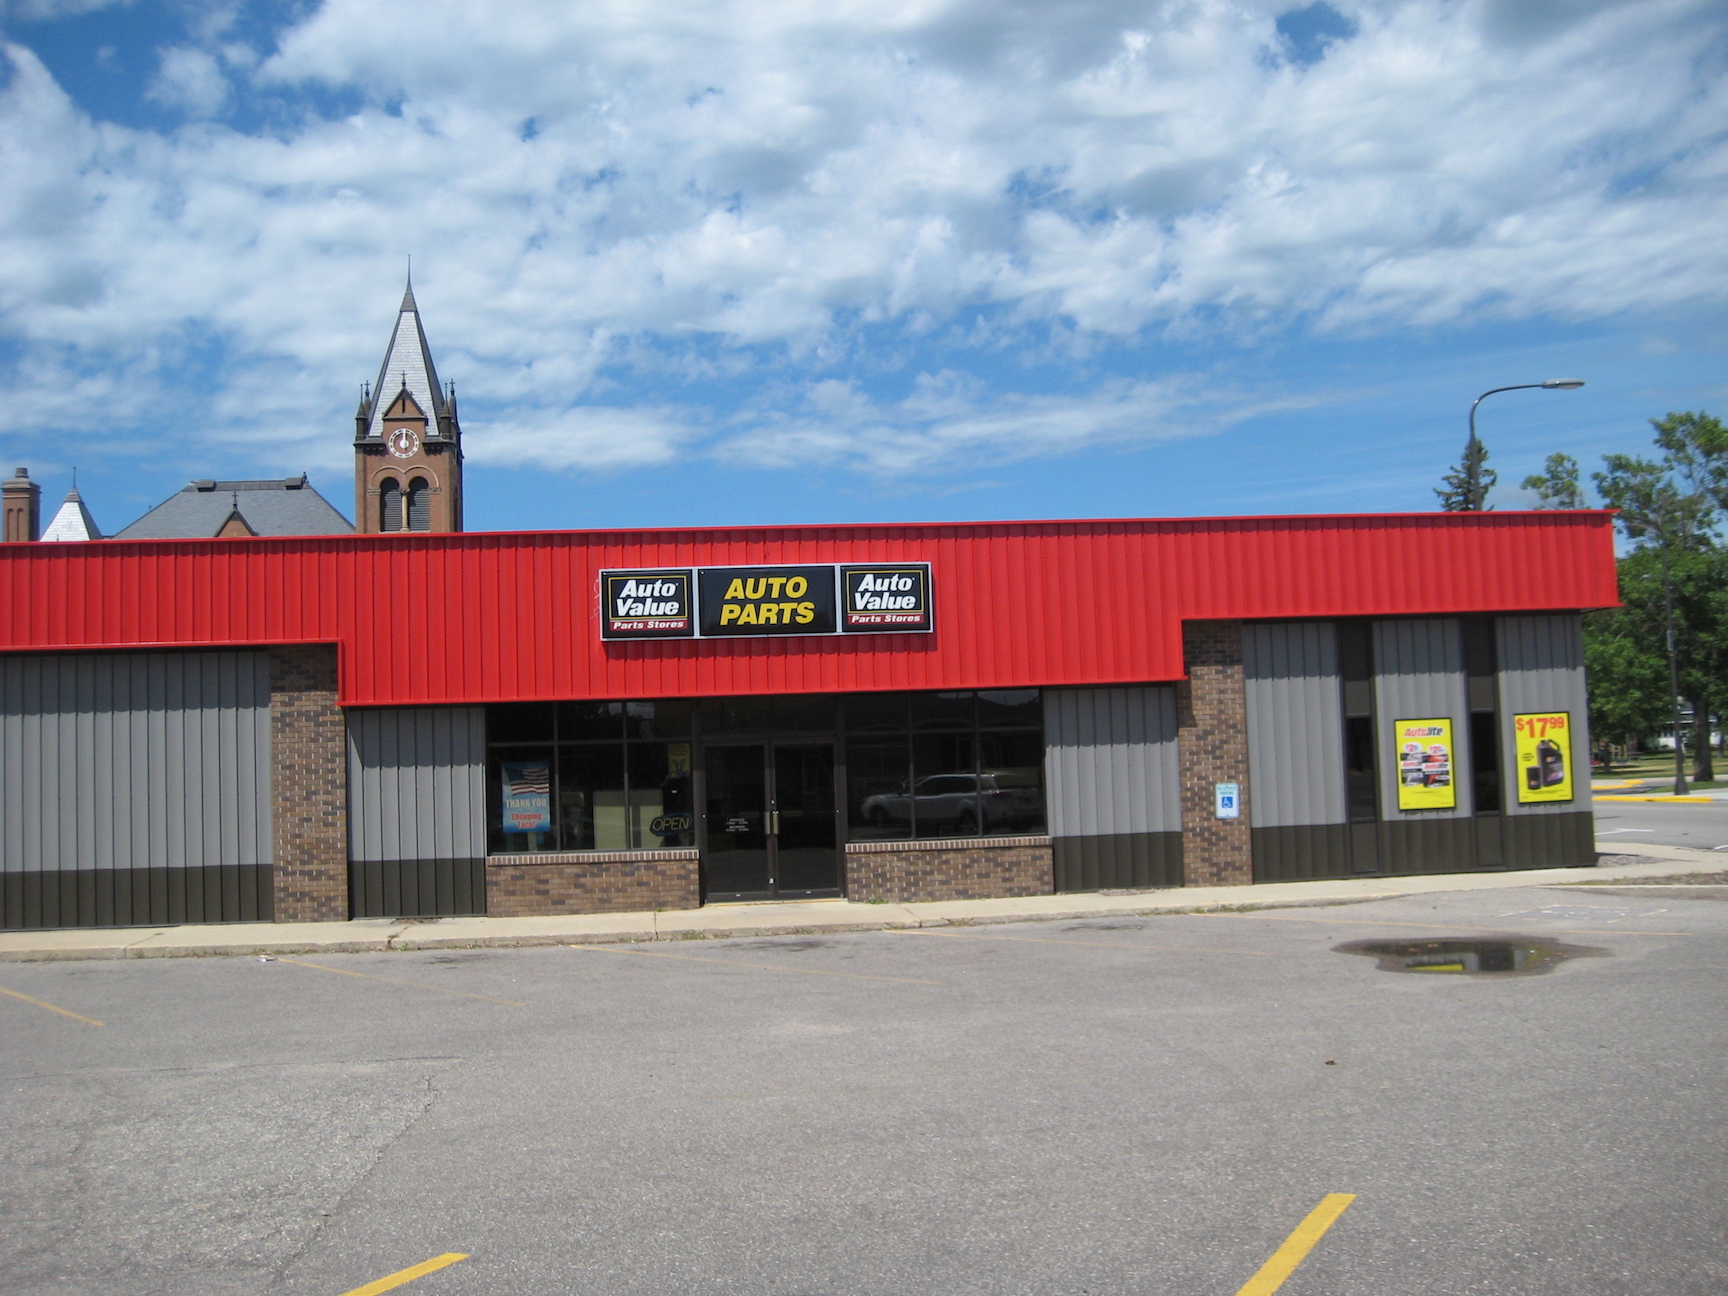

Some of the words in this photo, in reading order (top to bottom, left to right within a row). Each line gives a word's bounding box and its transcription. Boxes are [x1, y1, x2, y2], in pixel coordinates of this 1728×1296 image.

[619, 579, 676, 598] Auto
[724, 576, 807, 600] AUTO
[857, 574, 913, 592] Auto
[616, 597, 680, 616] Value
[854, 592, 916, 610] Value
[720, 601, 815, 626] PARTS
[851, 615, 882, 623] Parts
[884, 614, 921, 623] Stores
[613, 621, 644, 630] Parts
[647, 620, 684, 629] Stores
[1404, 726, 1443, 738] Autolite
[506, 799, 530, 808] THANK
[532, 798, 547, 808] YOU
[652, 817, 690, 832] OPEN
